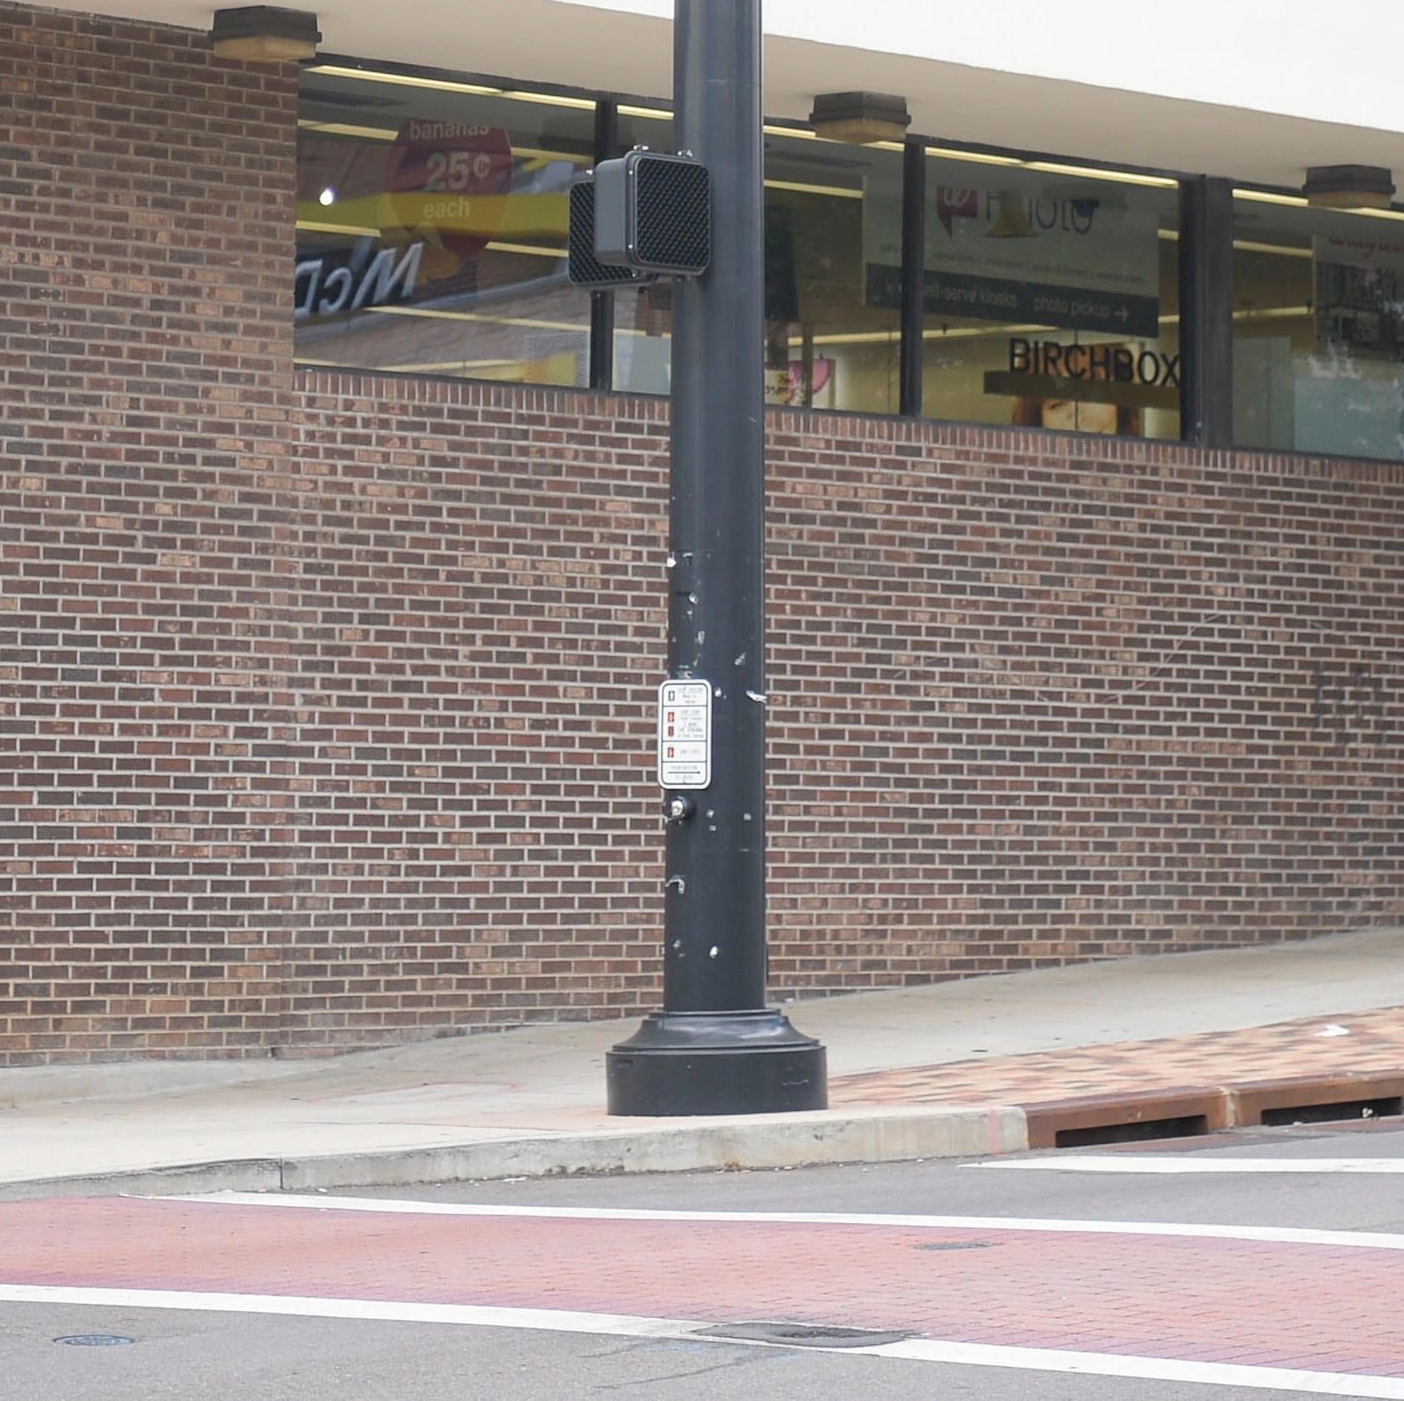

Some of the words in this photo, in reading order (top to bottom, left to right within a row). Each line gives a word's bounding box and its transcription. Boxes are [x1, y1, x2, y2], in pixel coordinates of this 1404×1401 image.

[409, 119, 490, 141] bananas
[423, 196, 470, 219] each
[1009, 337, 1180, 388] BIRCHBOX
